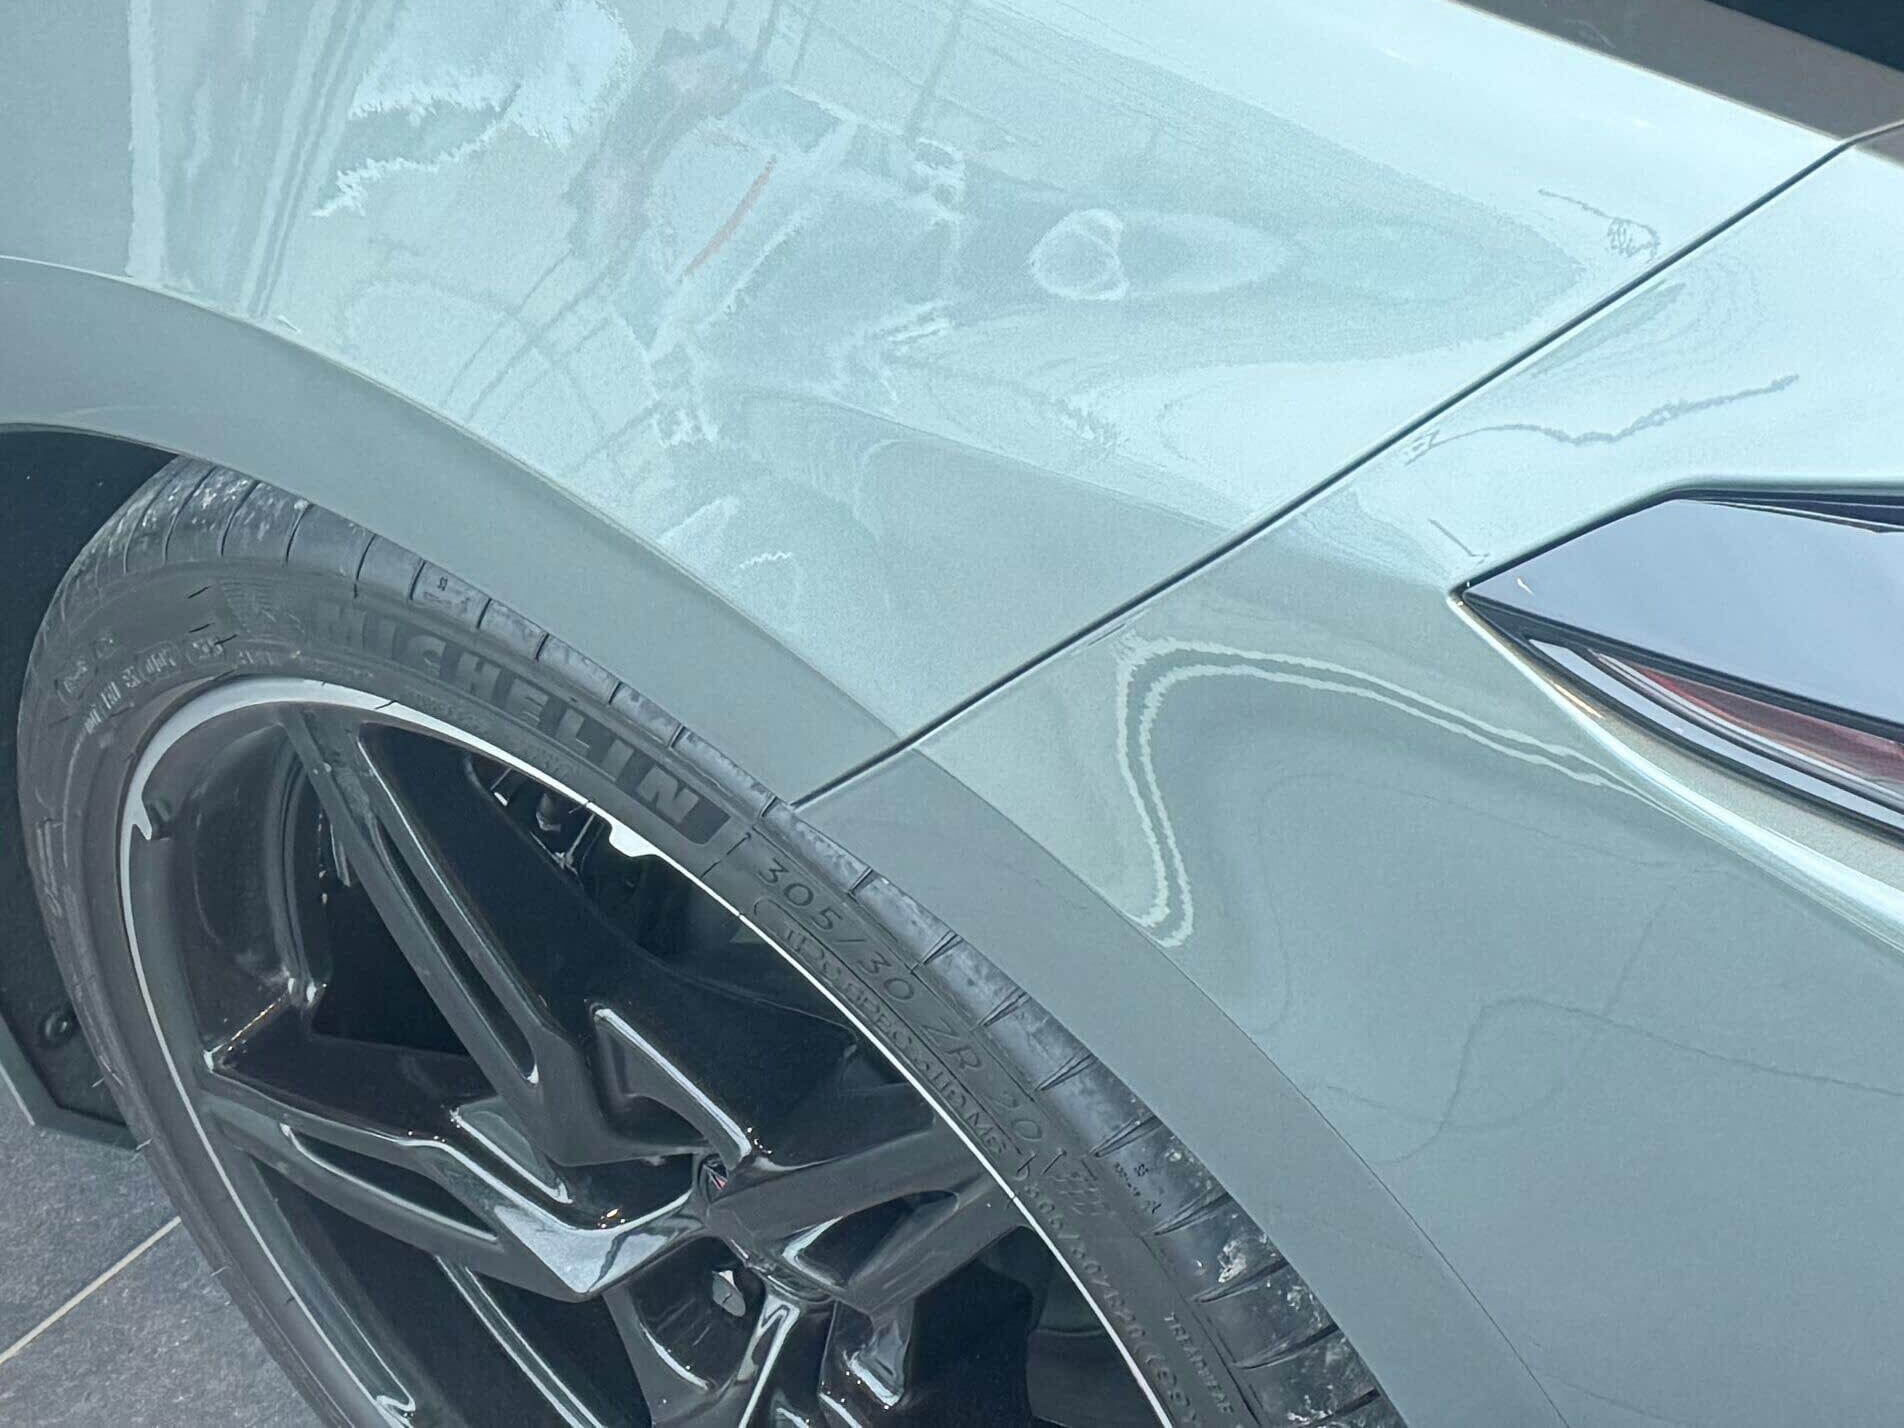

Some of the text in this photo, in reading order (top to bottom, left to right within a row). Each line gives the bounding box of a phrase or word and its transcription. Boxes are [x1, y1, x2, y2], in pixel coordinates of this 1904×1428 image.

[308, 599, 702, 827] MICHELIN
[756, 856, 917, 1002] 305/30
[919, 1014, 985, 1074] ZR
